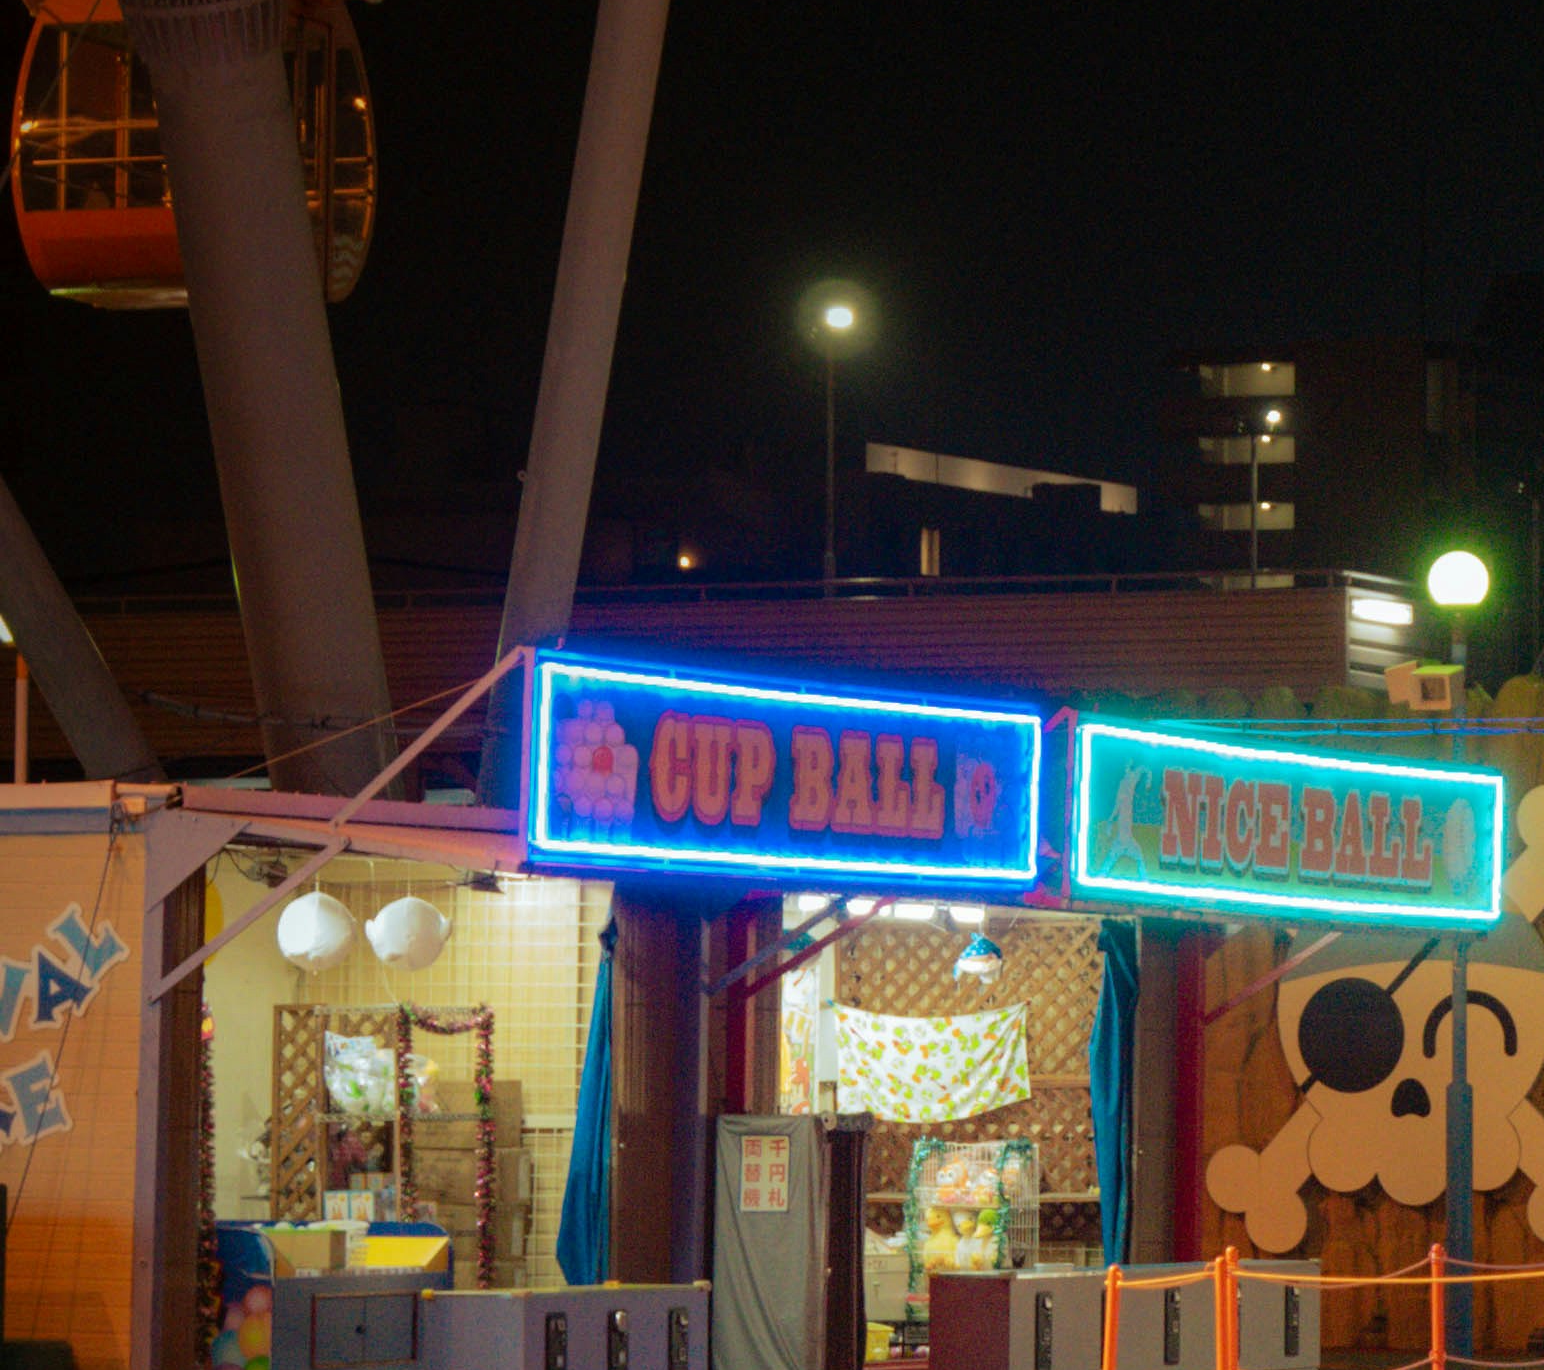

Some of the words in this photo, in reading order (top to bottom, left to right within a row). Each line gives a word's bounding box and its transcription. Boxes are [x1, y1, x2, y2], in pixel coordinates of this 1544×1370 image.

[650, 709, 776, 827] CUP
[787, 724, 946, 841] BALL
[1158, 767, 1291, 879] NICE
[1299, 784, 1434, 889] BALL
